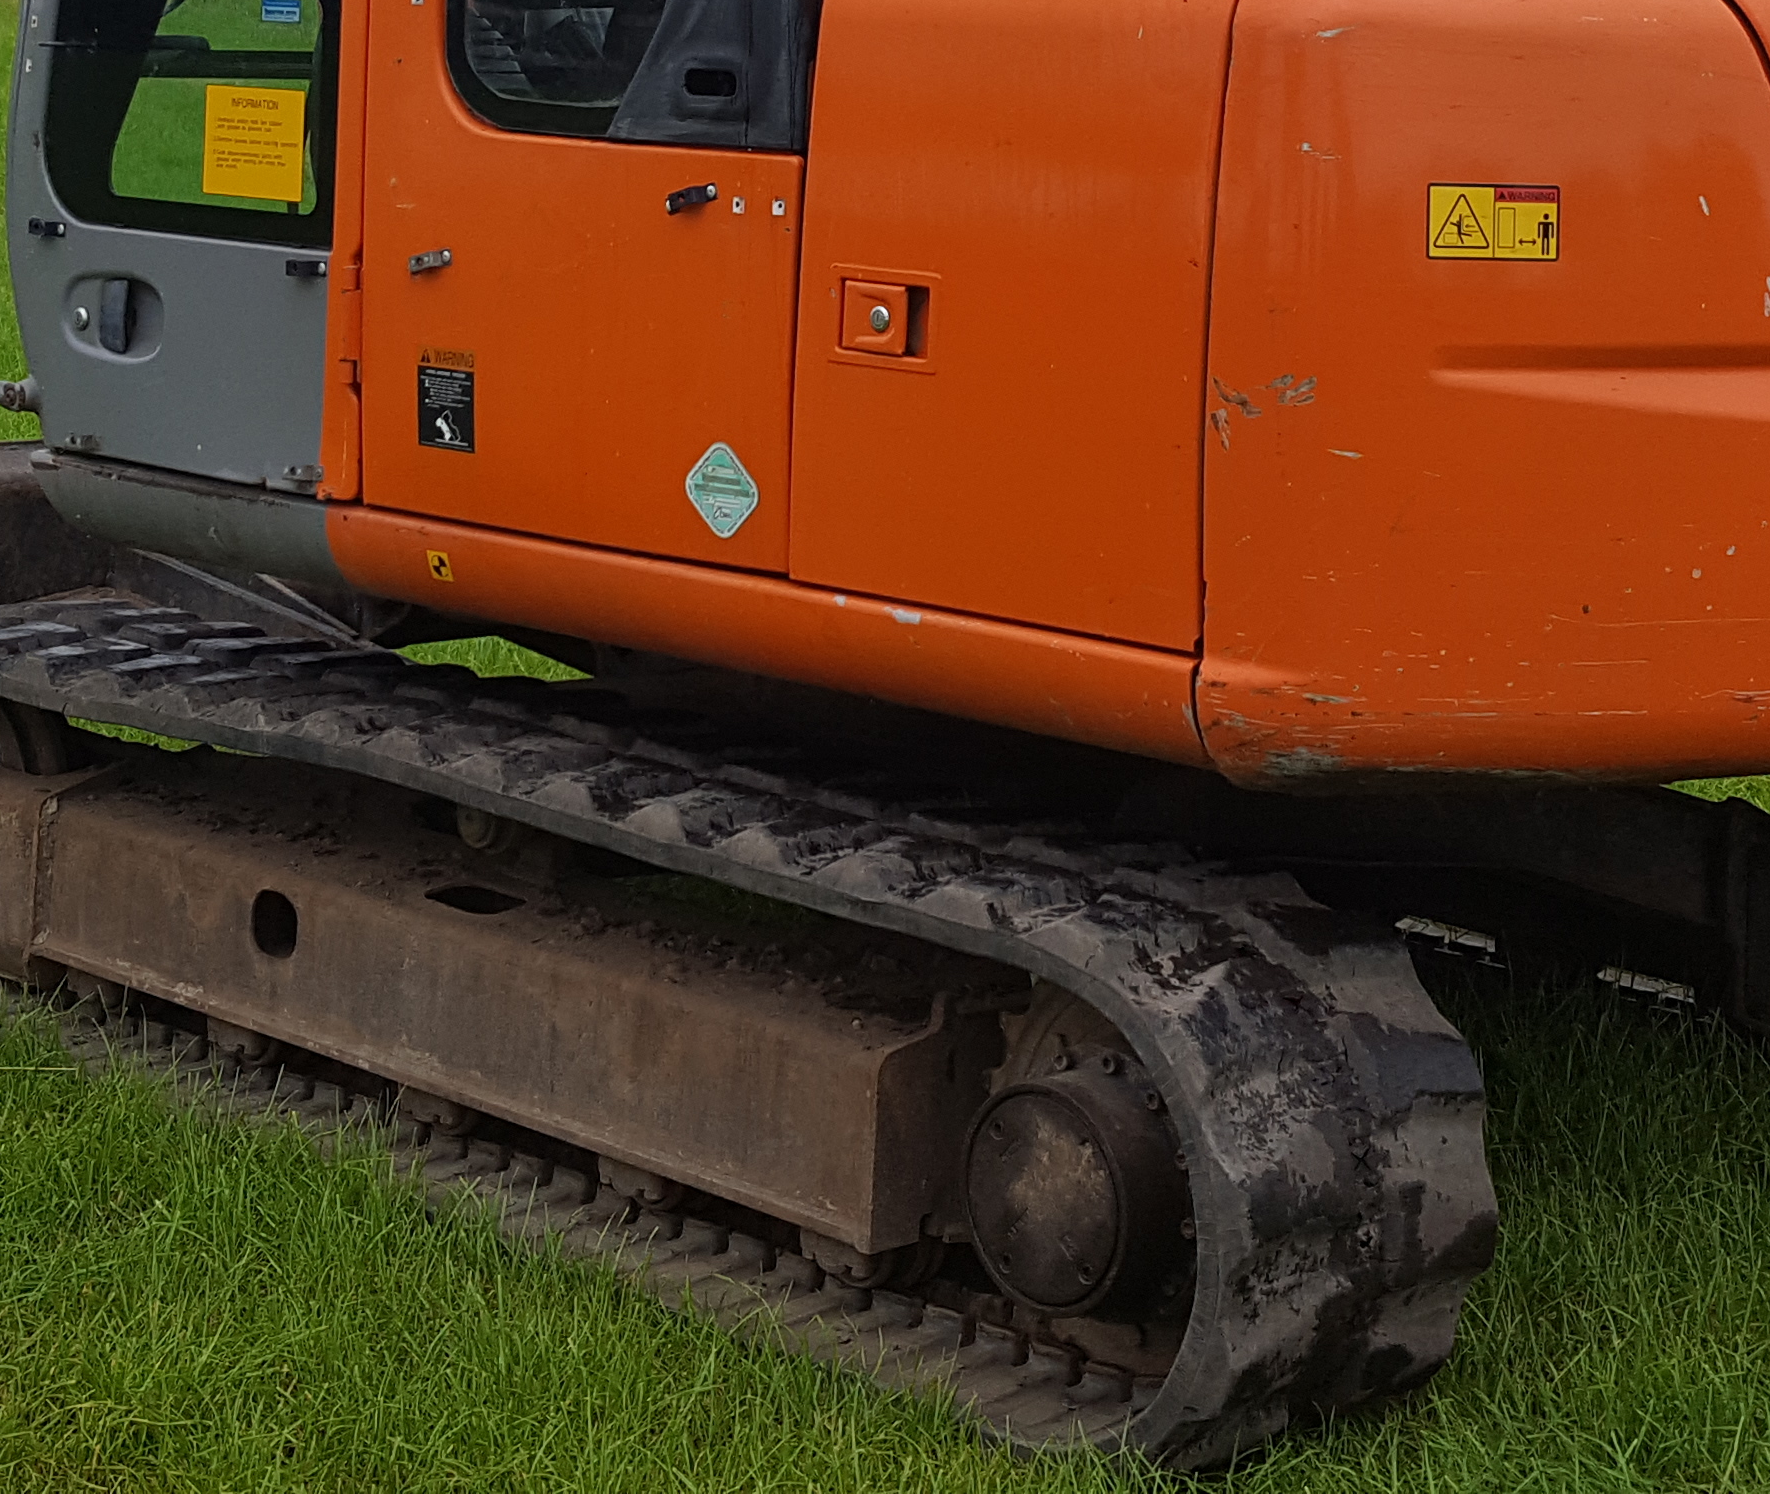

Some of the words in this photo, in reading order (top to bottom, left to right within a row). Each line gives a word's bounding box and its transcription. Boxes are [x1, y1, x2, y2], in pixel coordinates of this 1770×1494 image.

[231, 97, 279, 111] INFORMATION
[1506, 190, 1556, 201] WARNING
[434, 348, 474, 368] WARNING
